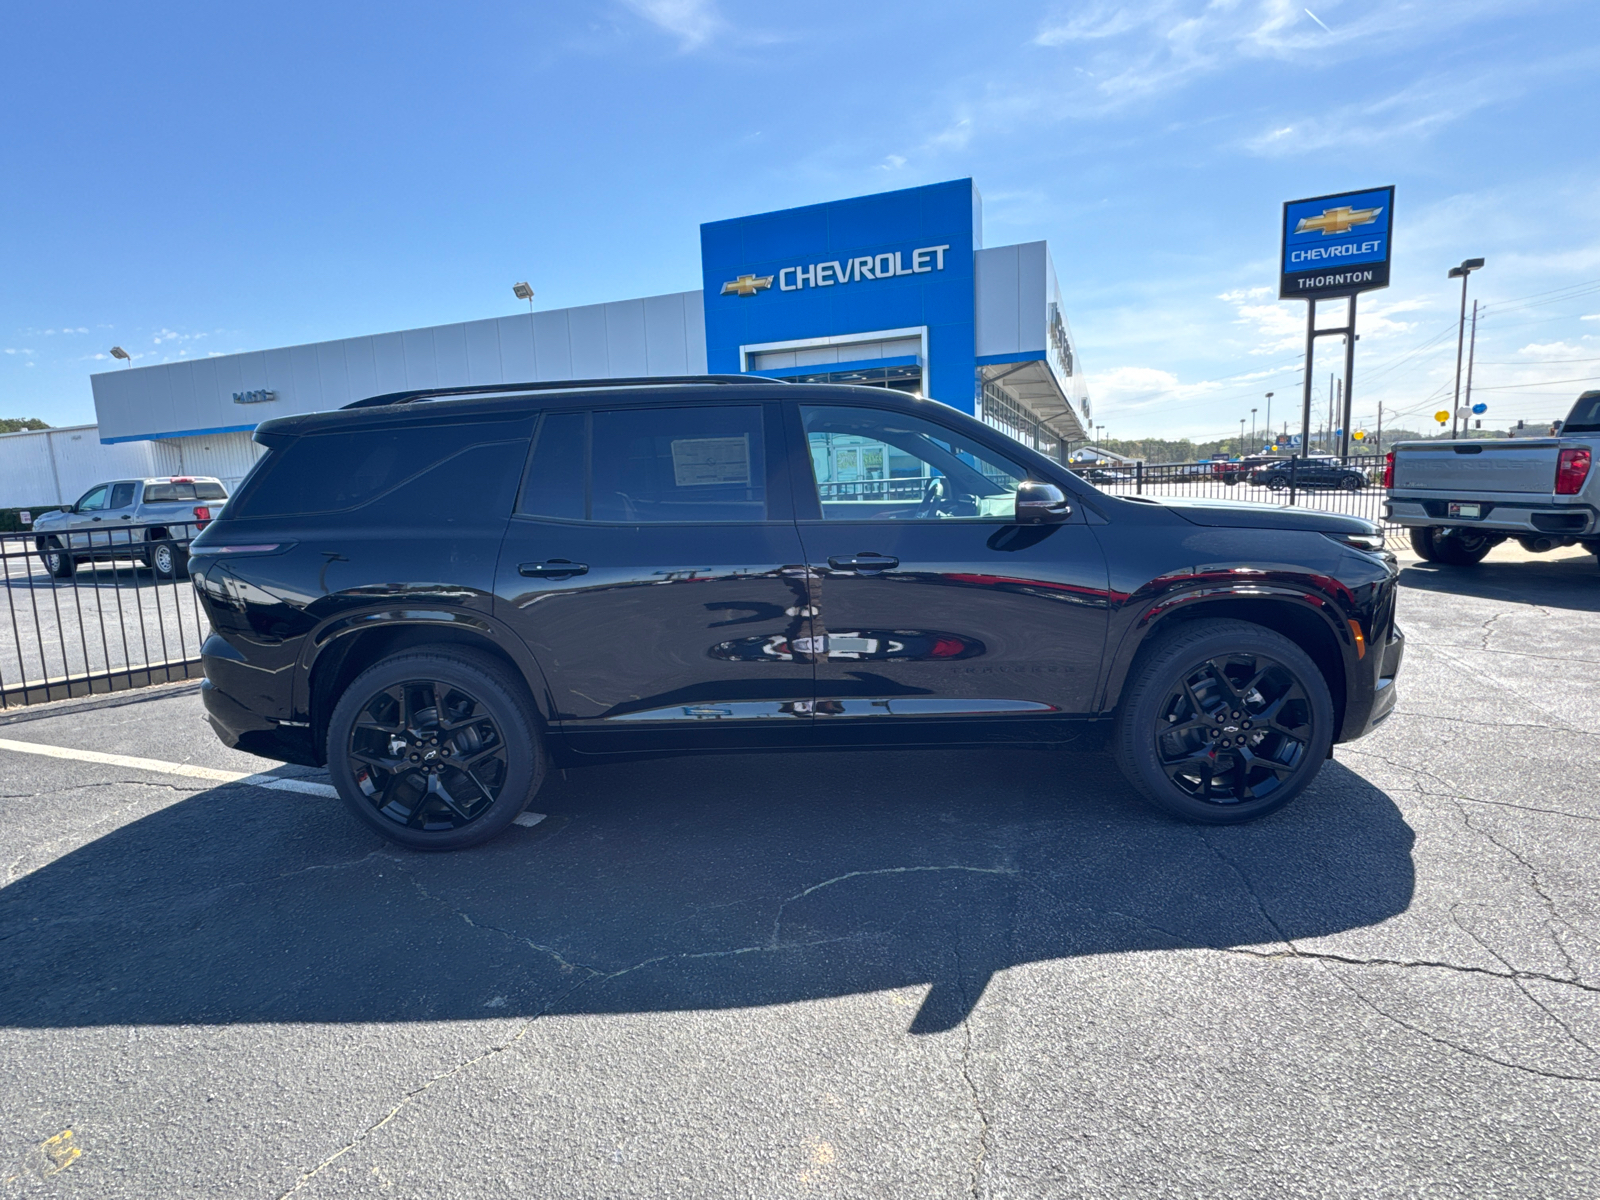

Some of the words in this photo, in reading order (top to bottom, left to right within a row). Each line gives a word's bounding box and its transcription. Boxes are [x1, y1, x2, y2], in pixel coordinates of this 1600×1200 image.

[1291, 240, 1381, 262] CHEVROLET
[780, 244, 950, 292] CHEVROLET
[1298, 271, 1372, 288] THORNTON
[1402, 459, 1544, 470] CHEVROLET
[950, 665, 1076, 674] TRAVERSE
